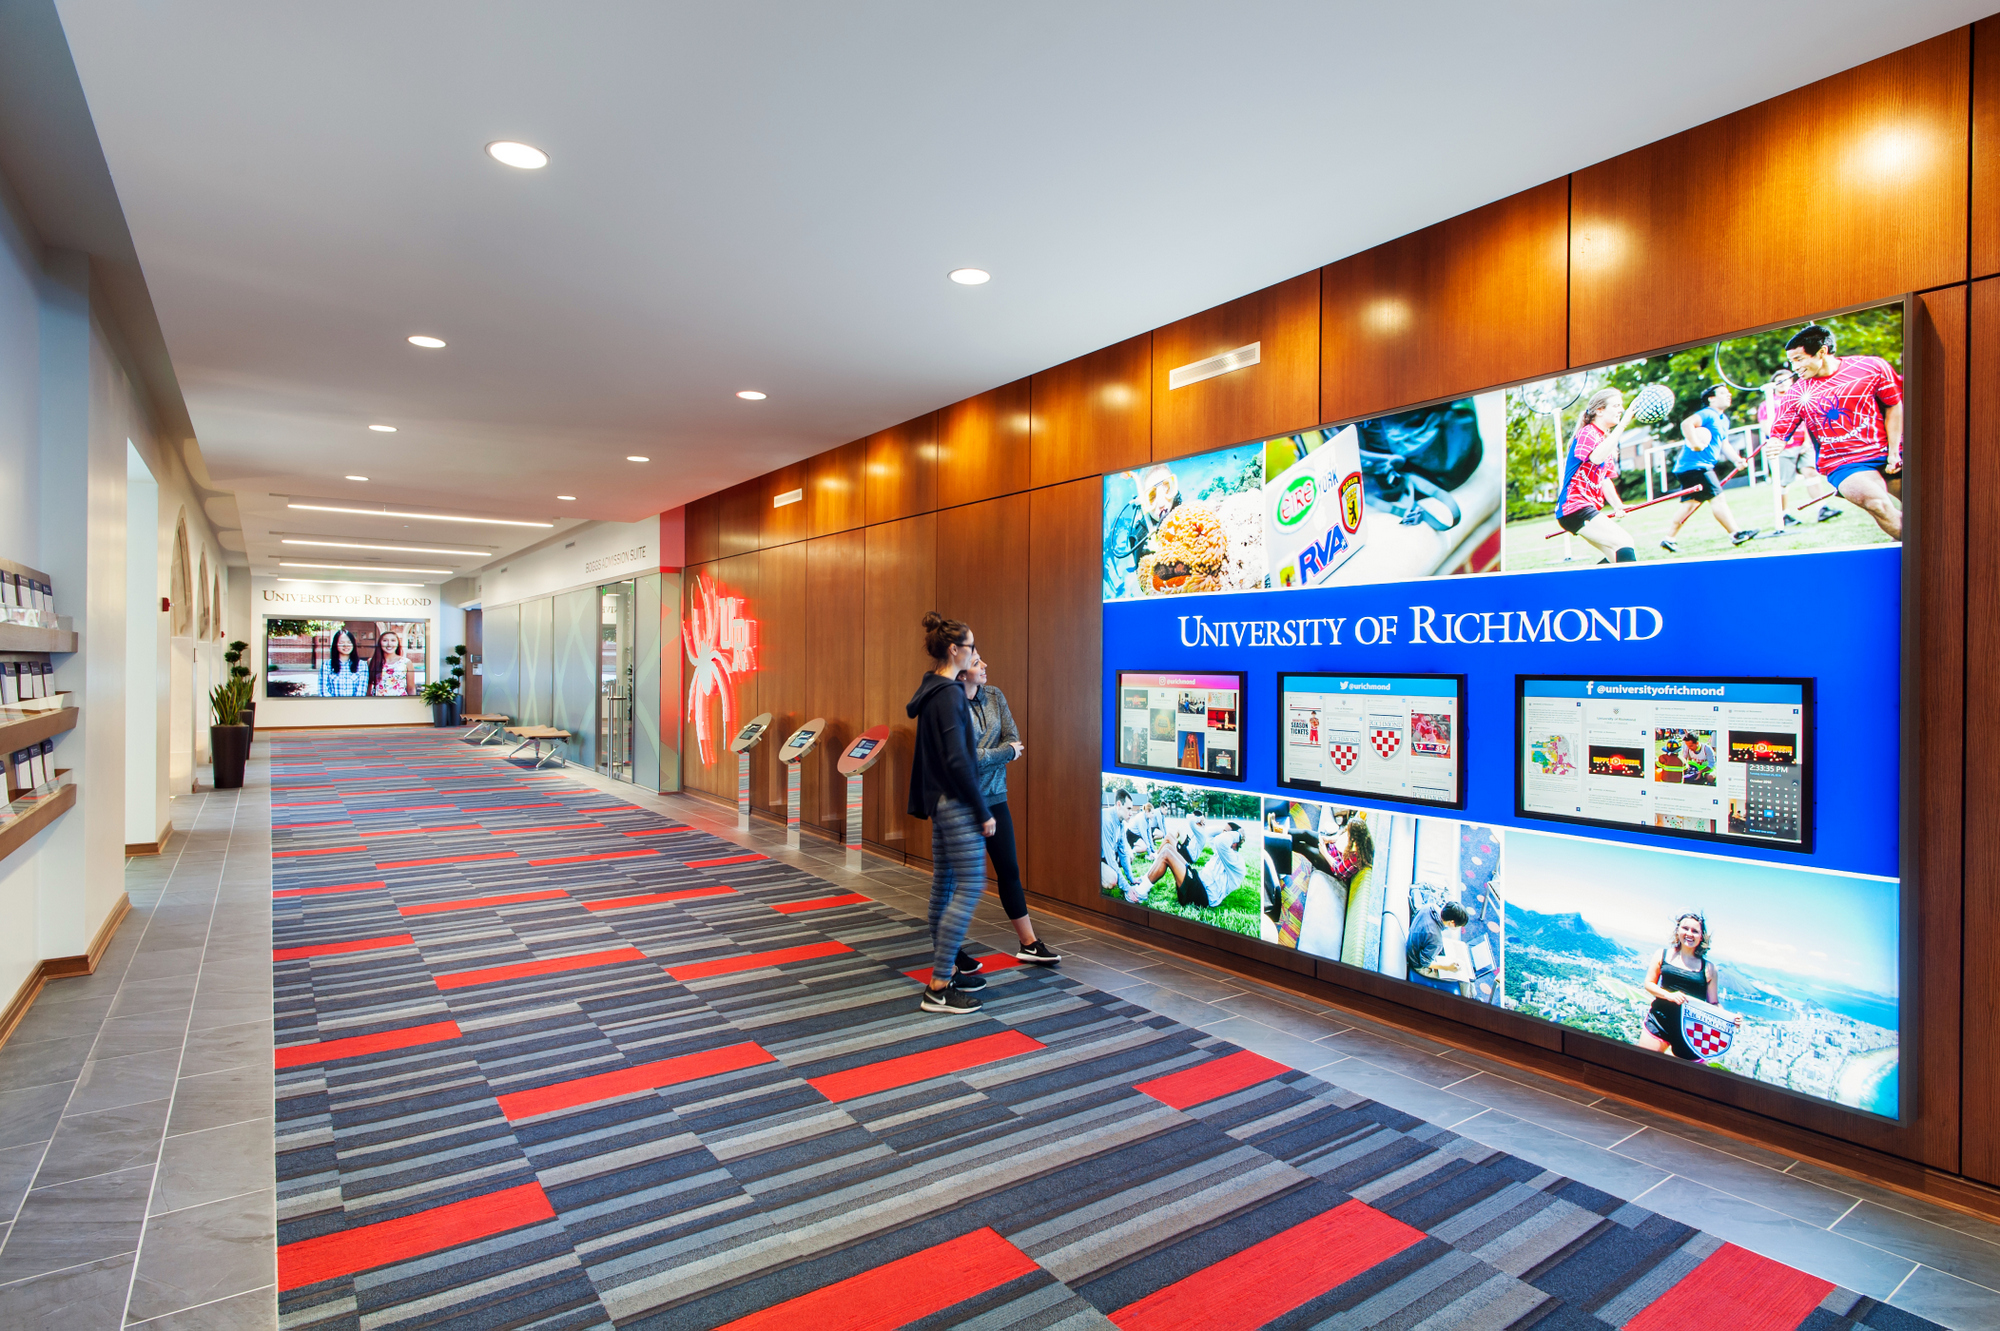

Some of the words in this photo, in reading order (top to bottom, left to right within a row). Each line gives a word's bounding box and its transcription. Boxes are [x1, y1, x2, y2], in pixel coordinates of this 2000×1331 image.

[585, 559, 601, 574] BOGGS
[602, 551, 630, 570] ADMISSION
[630, 545, 647, 561] SUITE
[1299, 522, 1349, 586] RVA
[262, 590, 342, 604] UNIVERSITY
[345, 595, 361, 605] OF
[364, 594, 432, 607] RICHMOND
[1178, 614, 1348, 648] UNIVERSITY
[1354, 615, 1398, 646] OF
[1408, 604, 1664, 645] RICHMOND
[1348, 683, 1391, 691] @urichmond
[1597, 684, 1725, 697] @universityofrichmond
[1290, 728, 1309, 736] TICKETS
[1749, 764, 1775, 772] 2:33:35
